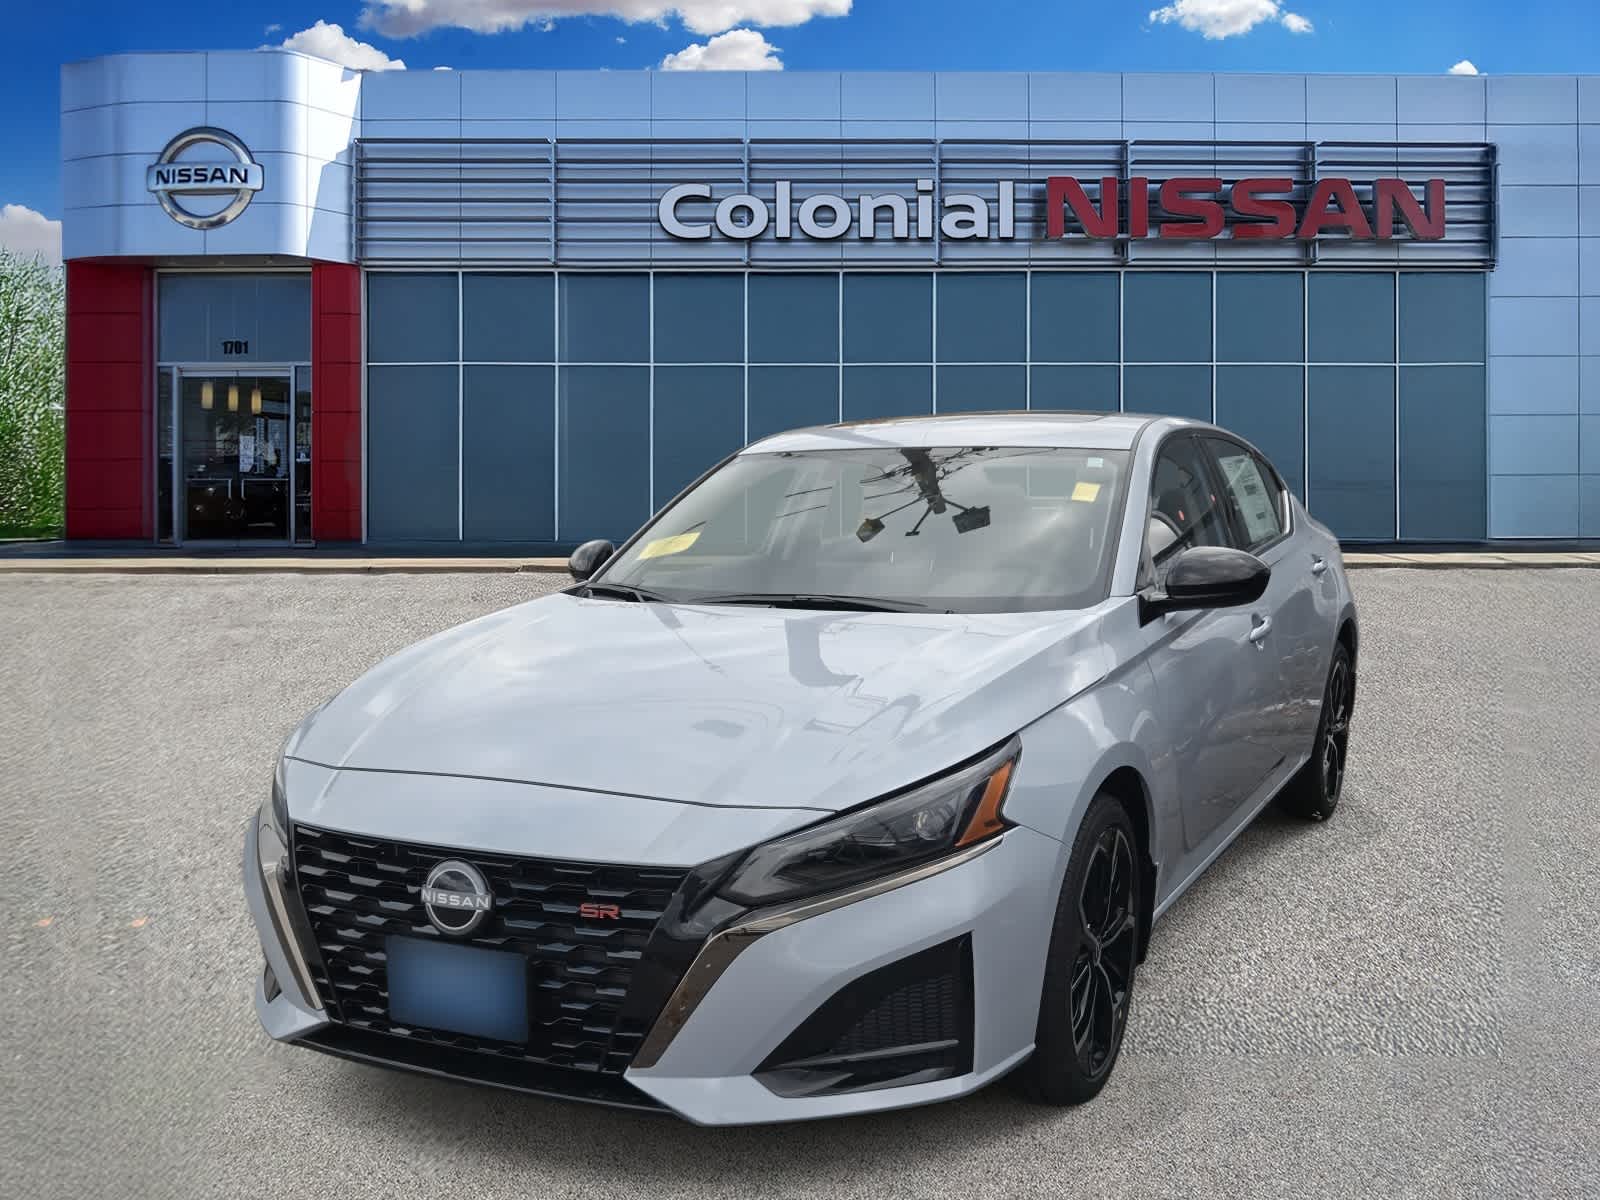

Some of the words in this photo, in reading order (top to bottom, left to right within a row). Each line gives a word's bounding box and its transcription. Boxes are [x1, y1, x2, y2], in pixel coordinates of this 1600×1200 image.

[156, 167, 248, 185] NISSAN
[658, 179, 1014, 240] Colonial
[1046, 176, 1446, 240] NISSAN
[222, 340, 249, 354] 1701
[421, 889, 490, 909] NISSAN
[579, 902, 620, 920] SR
